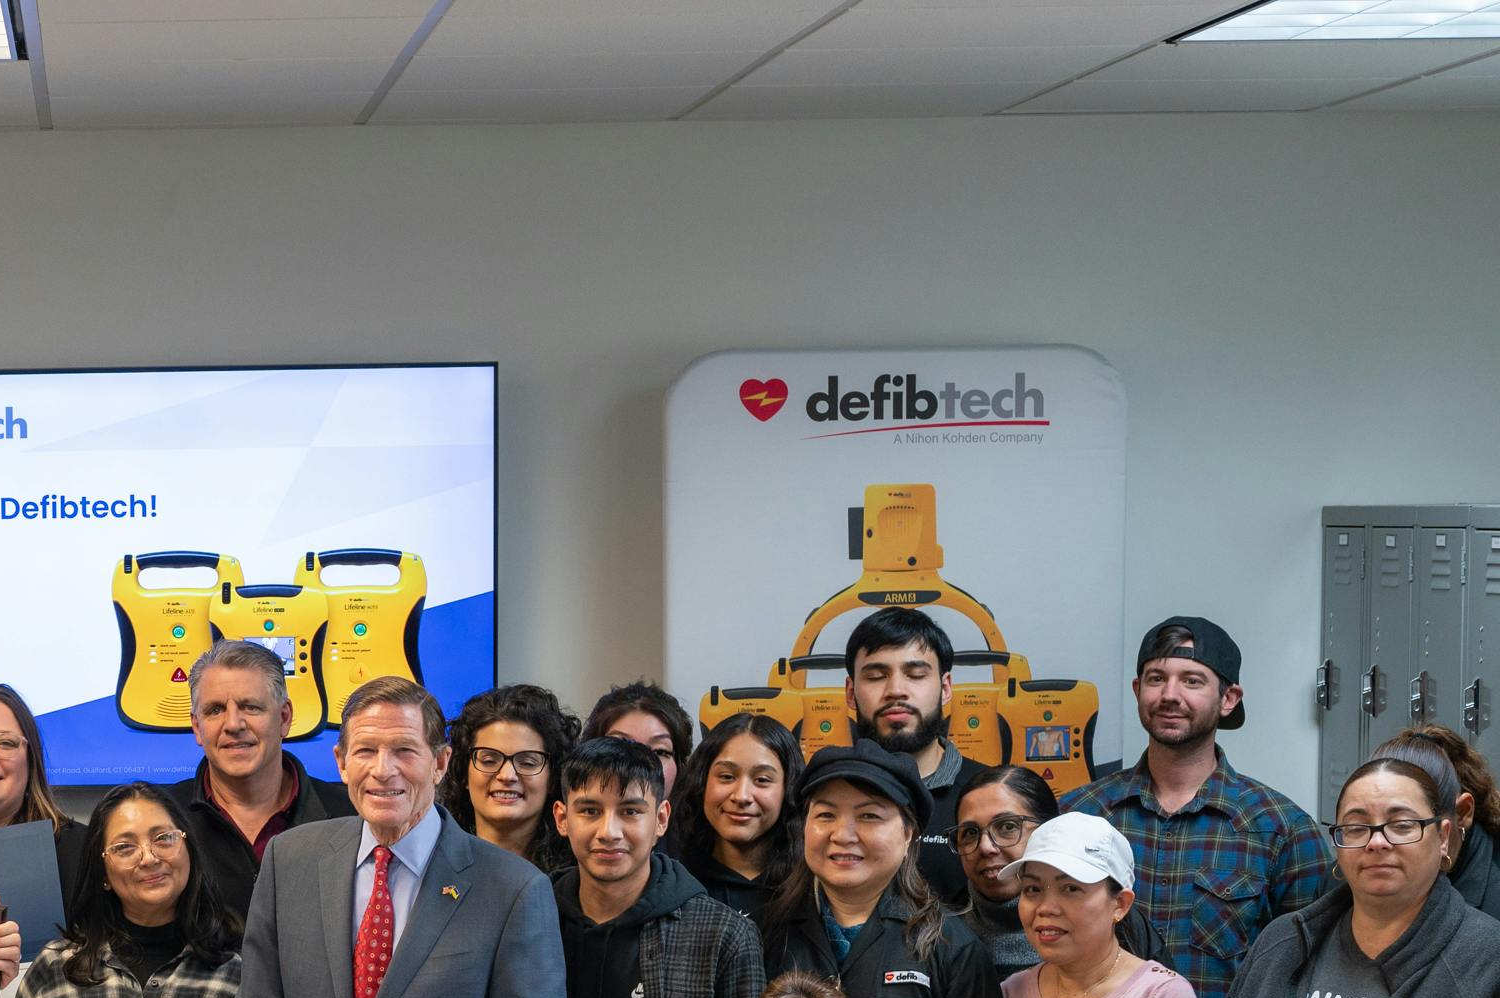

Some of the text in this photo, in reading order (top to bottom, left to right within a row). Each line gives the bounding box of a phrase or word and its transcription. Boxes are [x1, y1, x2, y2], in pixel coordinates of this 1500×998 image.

[806, 372, 1044, 422] defibtech
[893, 432, 1044, 445] A Nihon Kohden Company
[0, 494, 157, 520] Defibtech!
